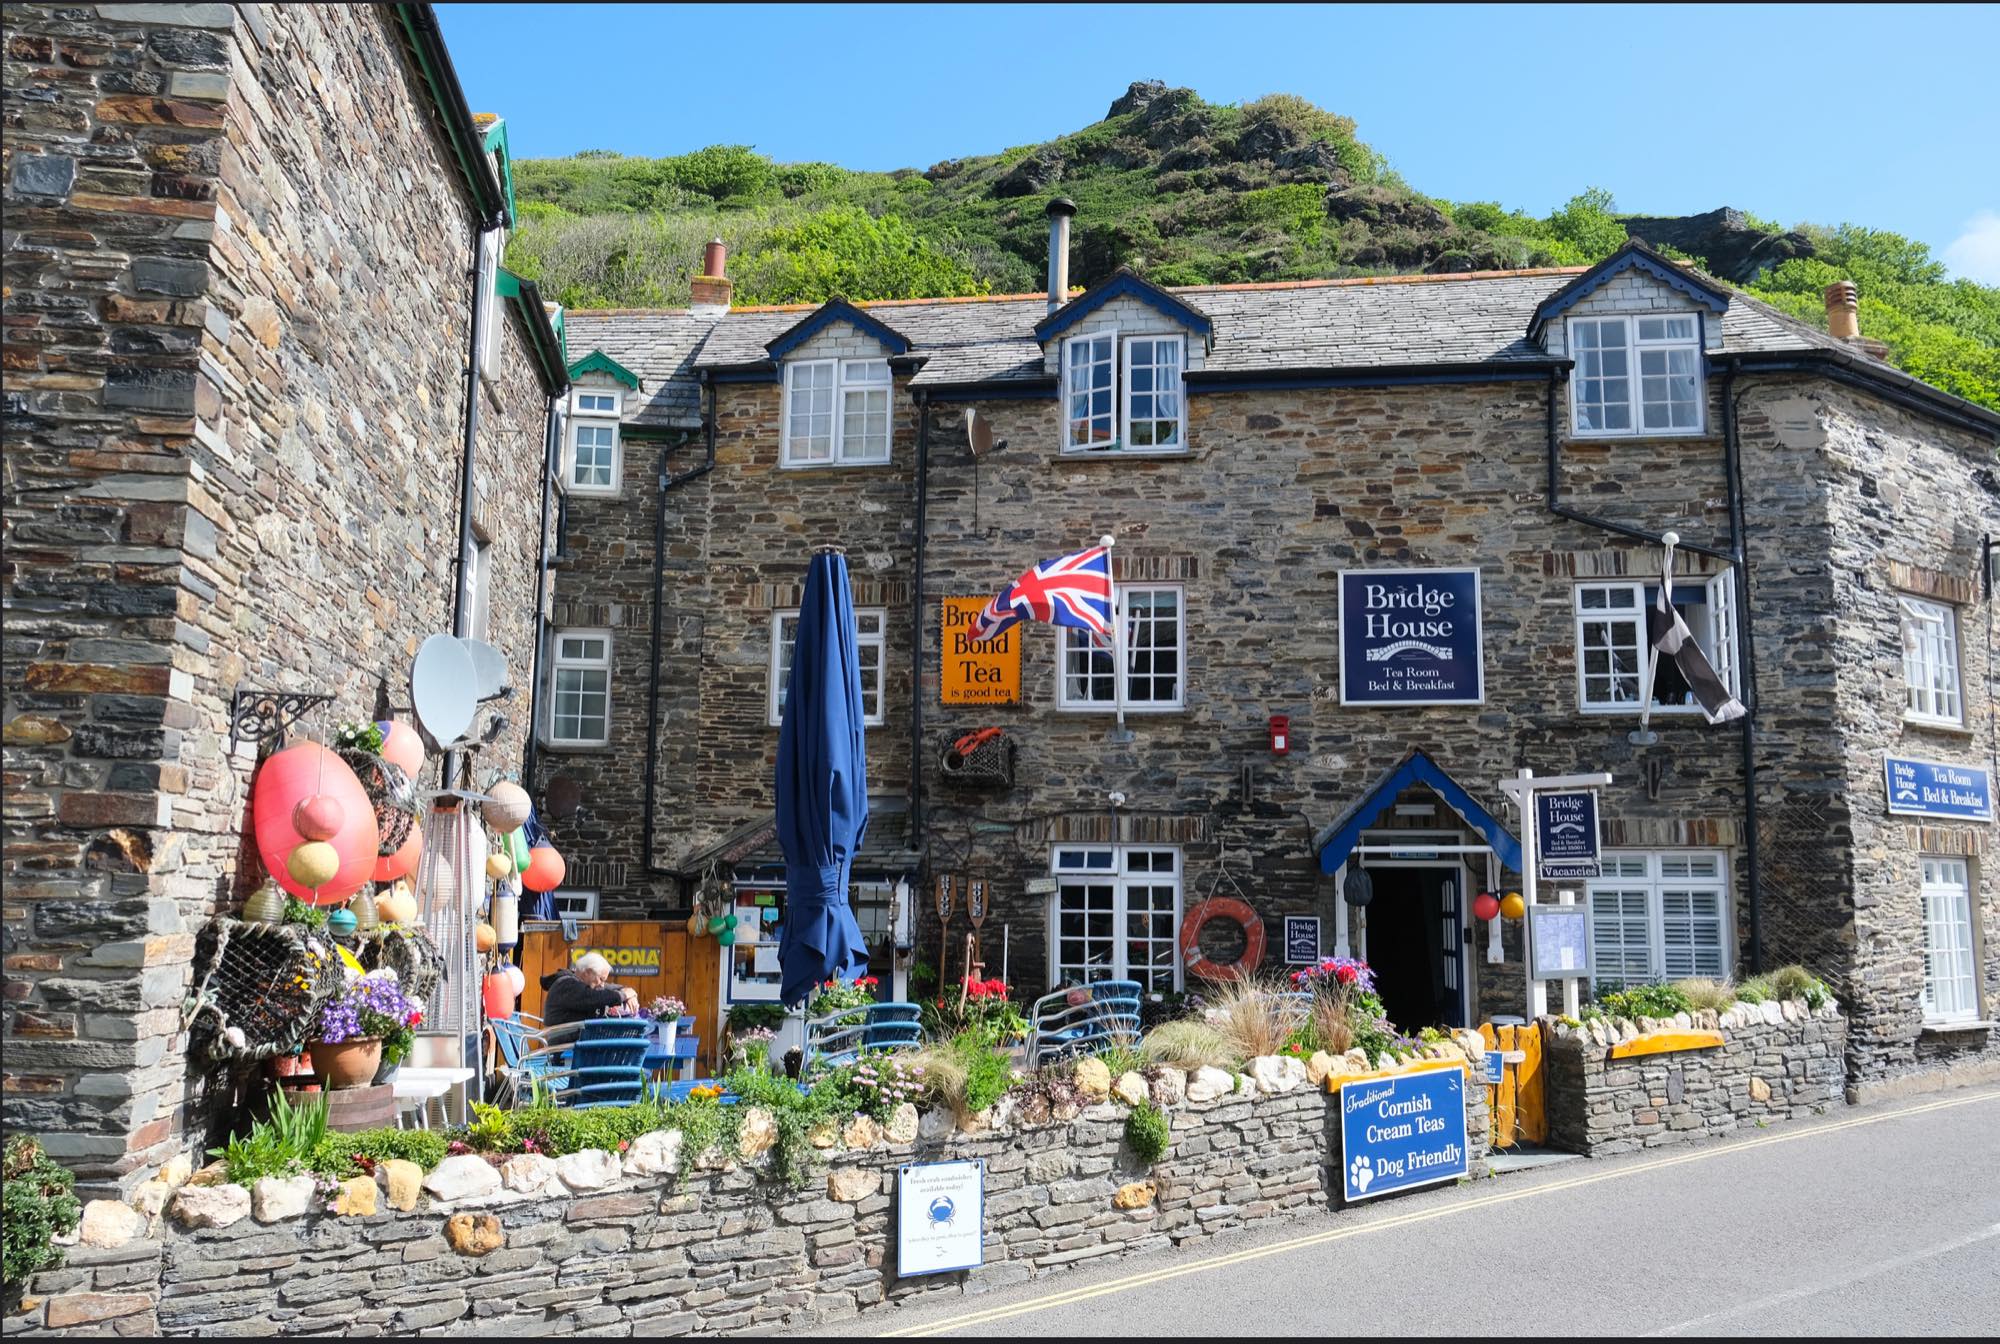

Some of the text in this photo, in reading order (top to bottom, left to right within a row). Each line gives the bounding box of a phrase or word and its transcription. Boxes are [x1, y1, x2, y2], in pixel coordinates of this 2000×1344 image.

[1365, 583, 1455, 616] Bridge
[945, 604, 980, 627] Bro
[1365, 613, 1453, 638] House
[953, 632, 1009, 655] Bond
[959, 661, 1002, 683] Tea
[1383, 667, 1440, 678] Tea Room
[951, 686, 1011, 699] is good tea
[1368, 680, 1456, 691] Bed & Breakfast
[1894, 763, 1916, 780] Bridge
[1931, 767, 1972, 787] Tea Room
[1895, 776, 1917, 790] House
[1549, 796, 1584, 812] Bridge
[1923, 786, 1940, 803] Bed
[1941, 788, 1949, 805] &
[1950, 789, 1984, 808] Breakfast
[1550, 810, 1585, 823] House
[1545, 866, 1597, 877] Vacancies
[1290, 921, 1316, 933] Bridge
[1290, 930, 1316, 939] House
[571, 948, 660, 967] CRONA
[1346, 1080, 1395, 1113] Traditional
[1378, 1093, 1433, 1118] Cornish
[1366, 1115, 1445, 1144] Cream Teas
[1376, 1143, 1462, 1178] Dog Friendly
